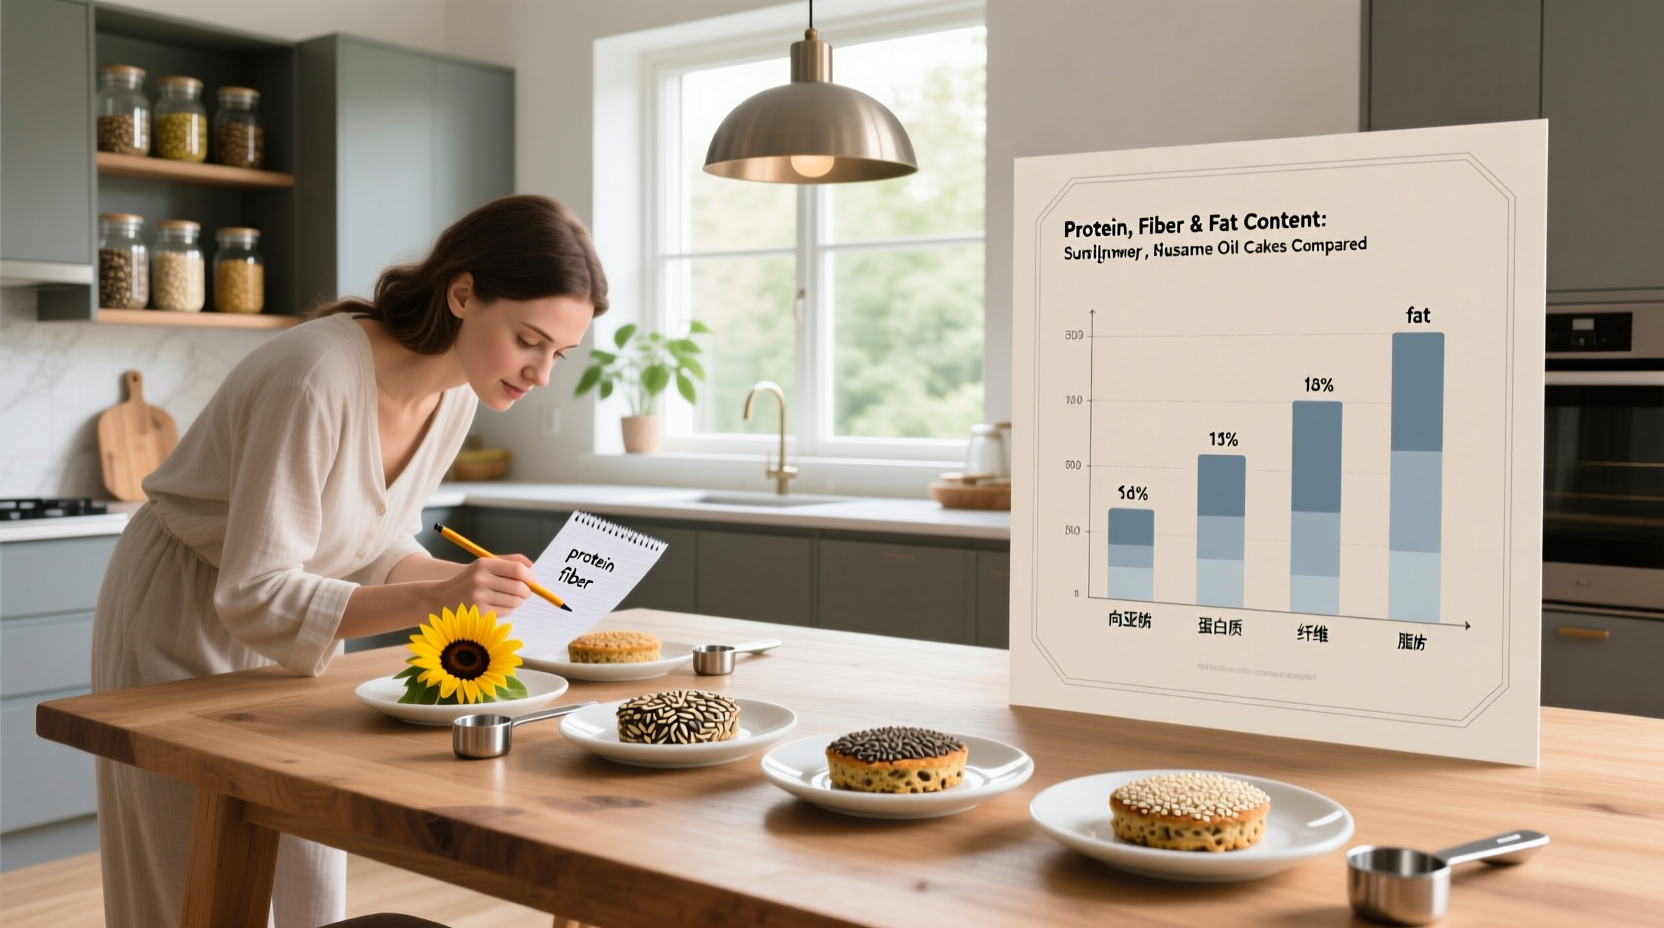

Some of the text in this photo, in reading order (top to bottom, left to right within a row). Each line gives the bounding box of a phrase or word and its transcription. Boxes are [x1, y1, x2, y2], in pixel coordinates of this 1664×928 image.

[1064, 210, 1327, 239] Protein, Fiber & Fat Content:
[1218, 239, 1239, 255] Oil
[1244, 239, 1287, 255] Cakes
[1291, 235, 1367, 256] Compared
[1405, 305, 1431, 324] fat
[1304, 376, 1334, 393] 18%
[565, 548, 615, 573] protein
[558, 566, 594, 590] fiber
[1198, 616, 1243, 636] 蛋白质
[1297, 623, 1329, 643] 纤维
